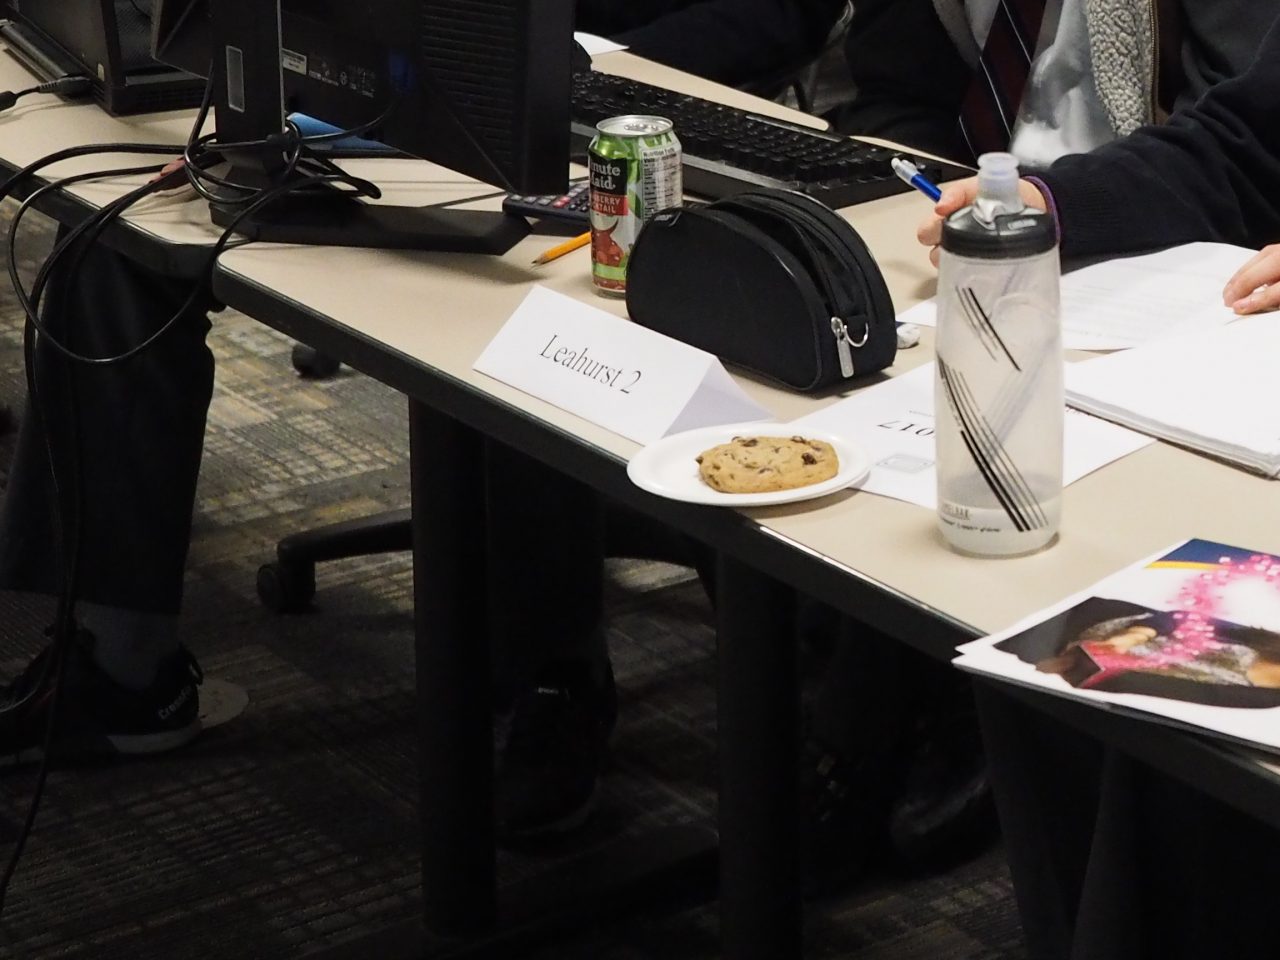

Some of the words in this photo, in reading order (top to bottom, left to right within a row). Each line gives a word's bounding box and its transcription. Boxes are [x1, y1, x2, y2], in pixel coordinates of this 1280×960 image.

[539, 334, 623, 388] Leahurst
[619, 369, 642, 394] 2
[876, 420, 936, 437] 017
